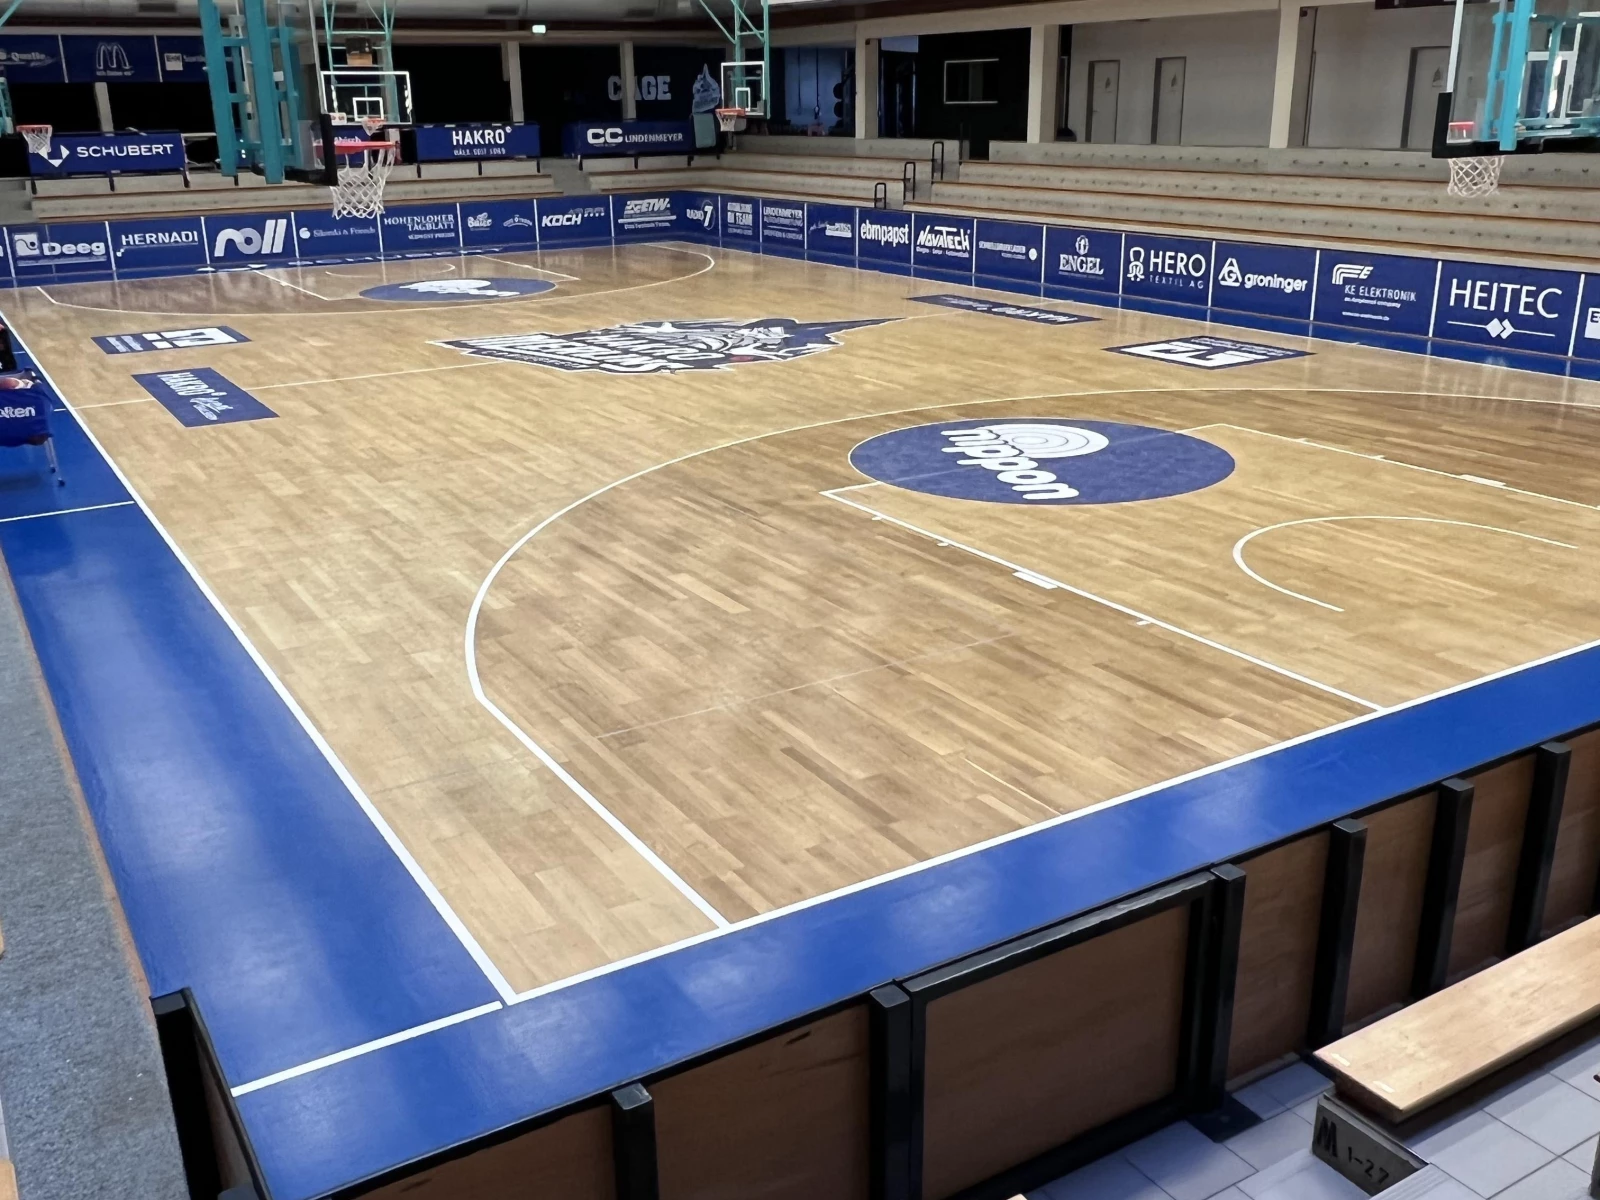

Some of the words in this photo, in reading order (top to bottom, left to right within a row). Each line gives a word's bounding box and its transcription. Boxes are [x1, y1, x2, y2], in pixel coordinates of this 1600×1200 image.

[607, 75, 672, 101] CGE
[452, 128, 505, 146] HAKRO
[586, 127, 623, 145] CC
[76, 143, 174, 158] SCHUBERT
[541, 213, 582, 228] KOCH
[42, 241, 105, 257] Deeg
[1058, 254, 1104, 276] ENGEL
[1149, 249, 1206, 278] HERO
[1188, 280, 1205, 289] AG
[1244, 272, 1308, 294] groninger
[1358, 285, 1417, 302] ELEKTRONIK
[1449, 277, 1563, 319] HEITEC
[1316, 1116, 1338, 1157] M
